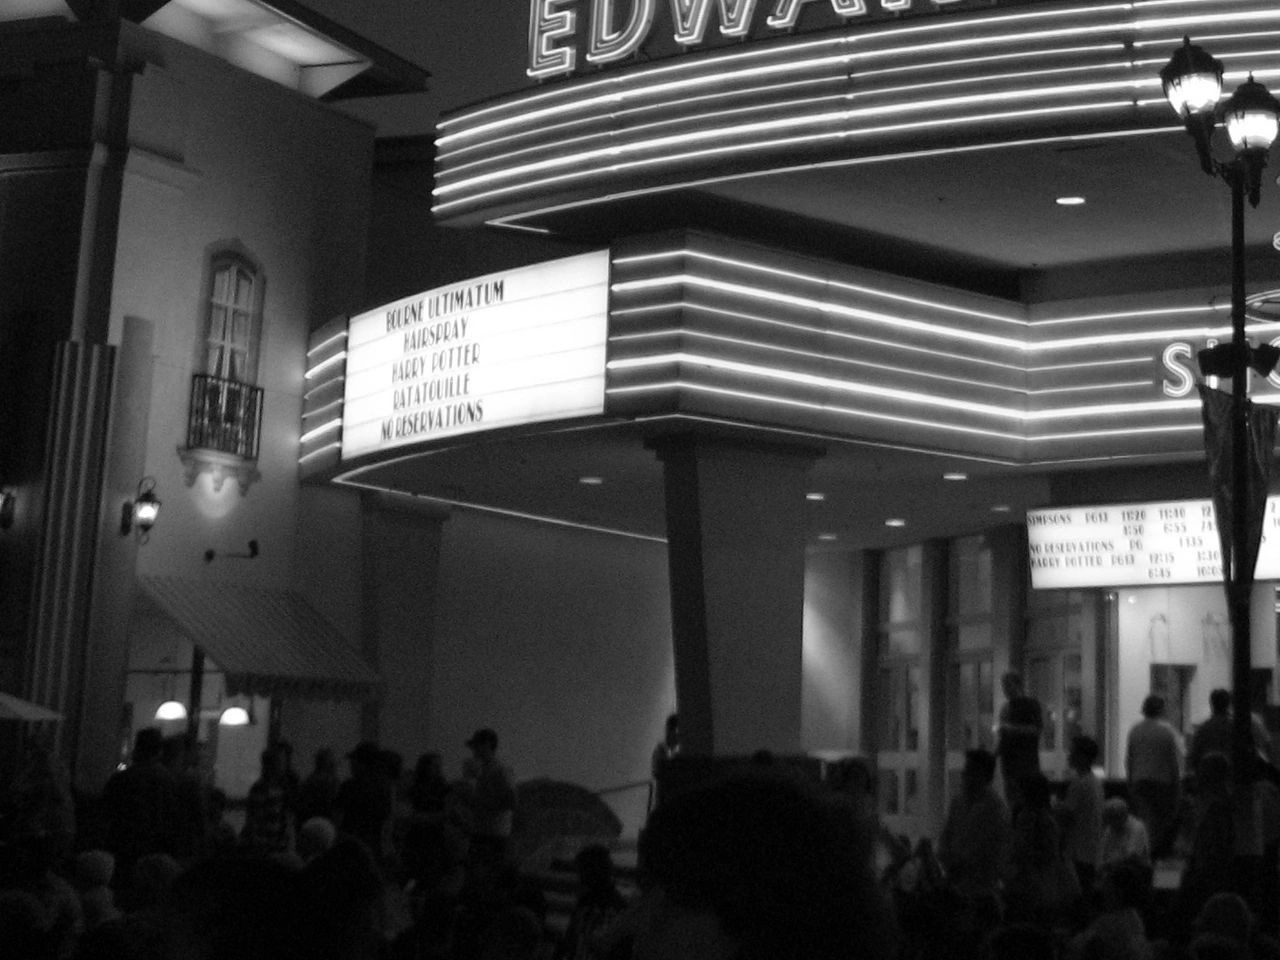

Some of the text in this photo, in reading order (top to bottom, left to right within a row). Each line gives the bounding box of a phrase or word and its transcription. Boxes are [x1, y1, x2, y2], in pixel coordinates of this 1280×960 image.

[386, 279, 505, 333] BOURNE ULTIMATUM
[403, 316, 470, 353] HAIRSPRAY
[391, 342, 481, 384] HARRY POTTER
[392, 371, 471, 411] RATATOUILLE
[381, 399, 484, 441] NO RESERVATIONS
